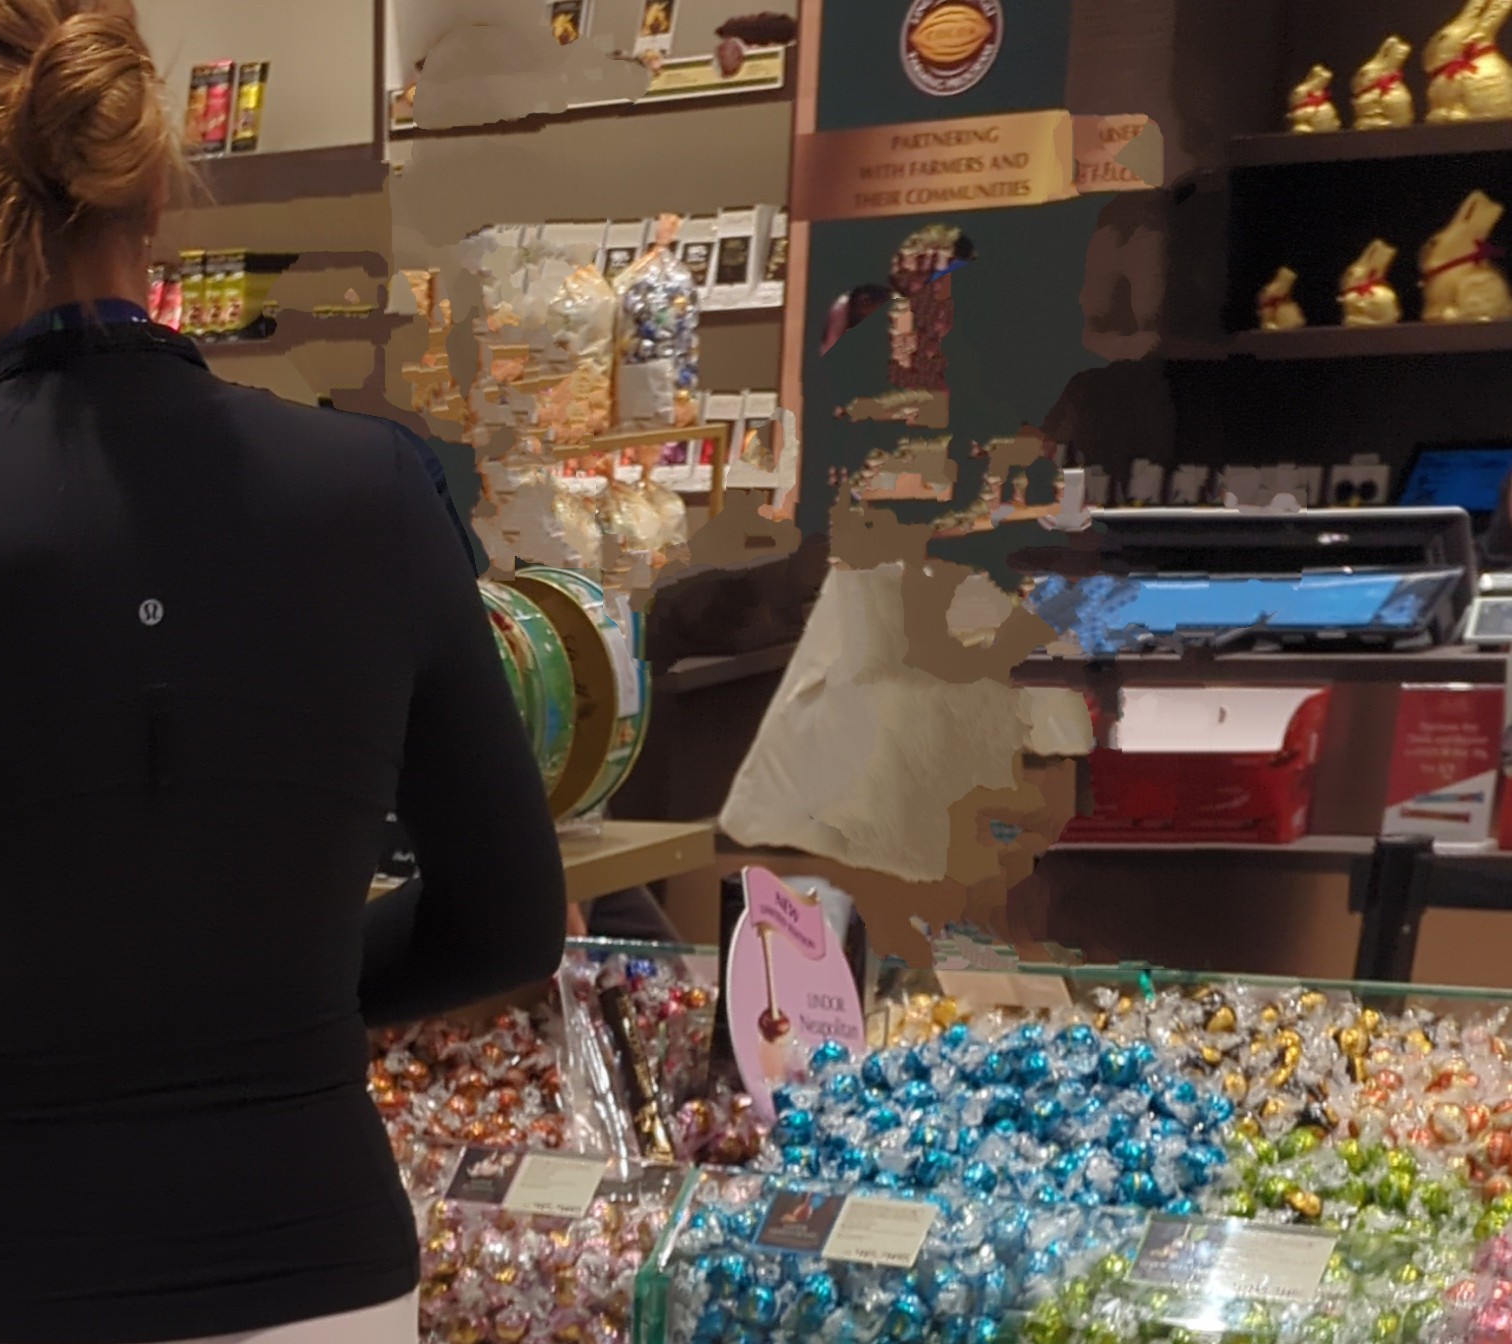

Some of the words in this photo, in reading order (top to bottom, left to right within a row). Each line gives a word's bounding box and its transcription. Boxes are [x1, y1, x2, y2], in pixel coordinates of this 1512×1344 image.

[891, 126, 999, 150] PARTNERING
[859, 163, 904, 180] WITH
[909, 156, 984, 178] FARMERS
[991, 152, 1030, 171] AND
[905, 180, 1031, 205] COMMUNITIES
[776, 891, 799, 922] NEW
[807, 993, 846, 1012] LINDOR
[799, 1013, 860, 1039] Neapolitan
